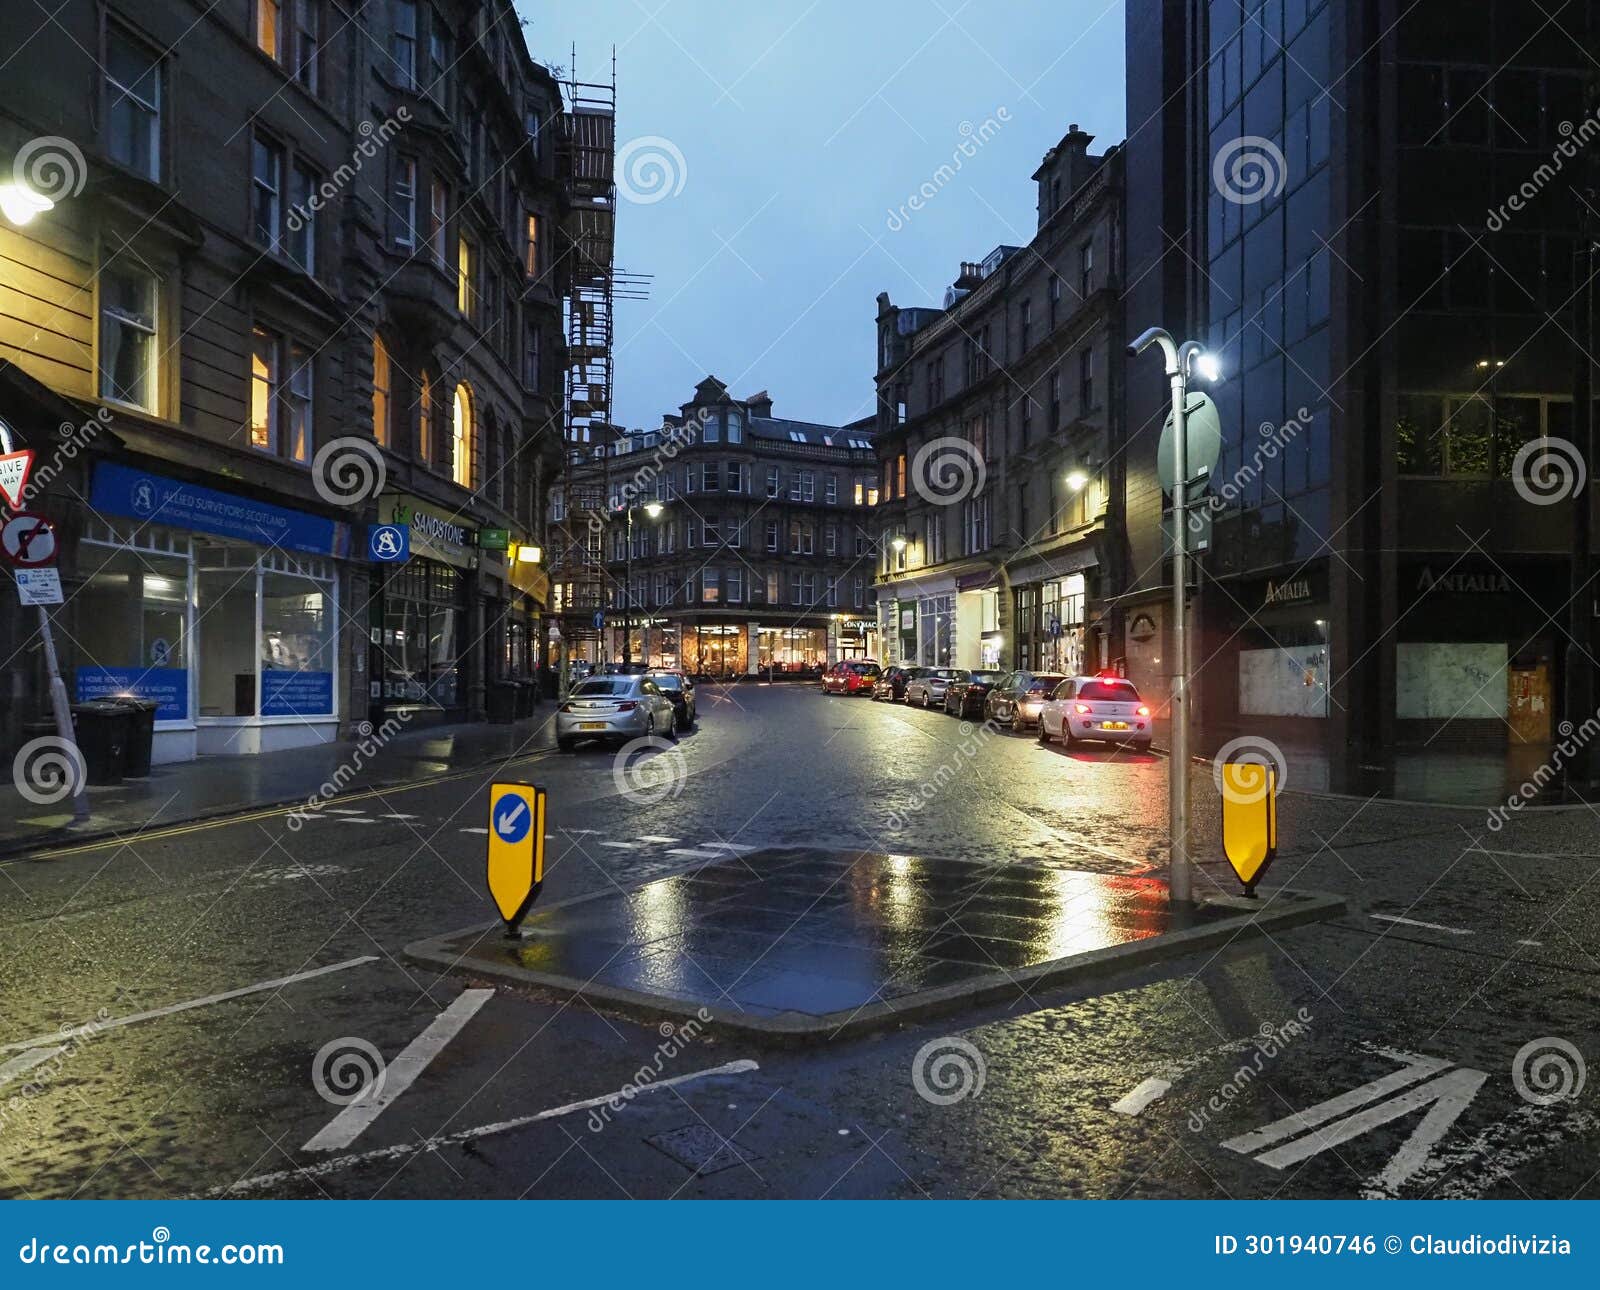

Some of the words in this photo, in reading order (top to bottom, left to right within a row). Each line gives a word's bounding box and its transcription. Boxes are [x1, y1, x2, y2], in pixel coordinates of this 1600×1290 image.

[3, 476, 19, 485] WAY
[195, 497, 245, 520] SURVEYORS
[246, 508, 288, 528] SCOTLAND
[414, 511, 465, 546] SANDSTONE
